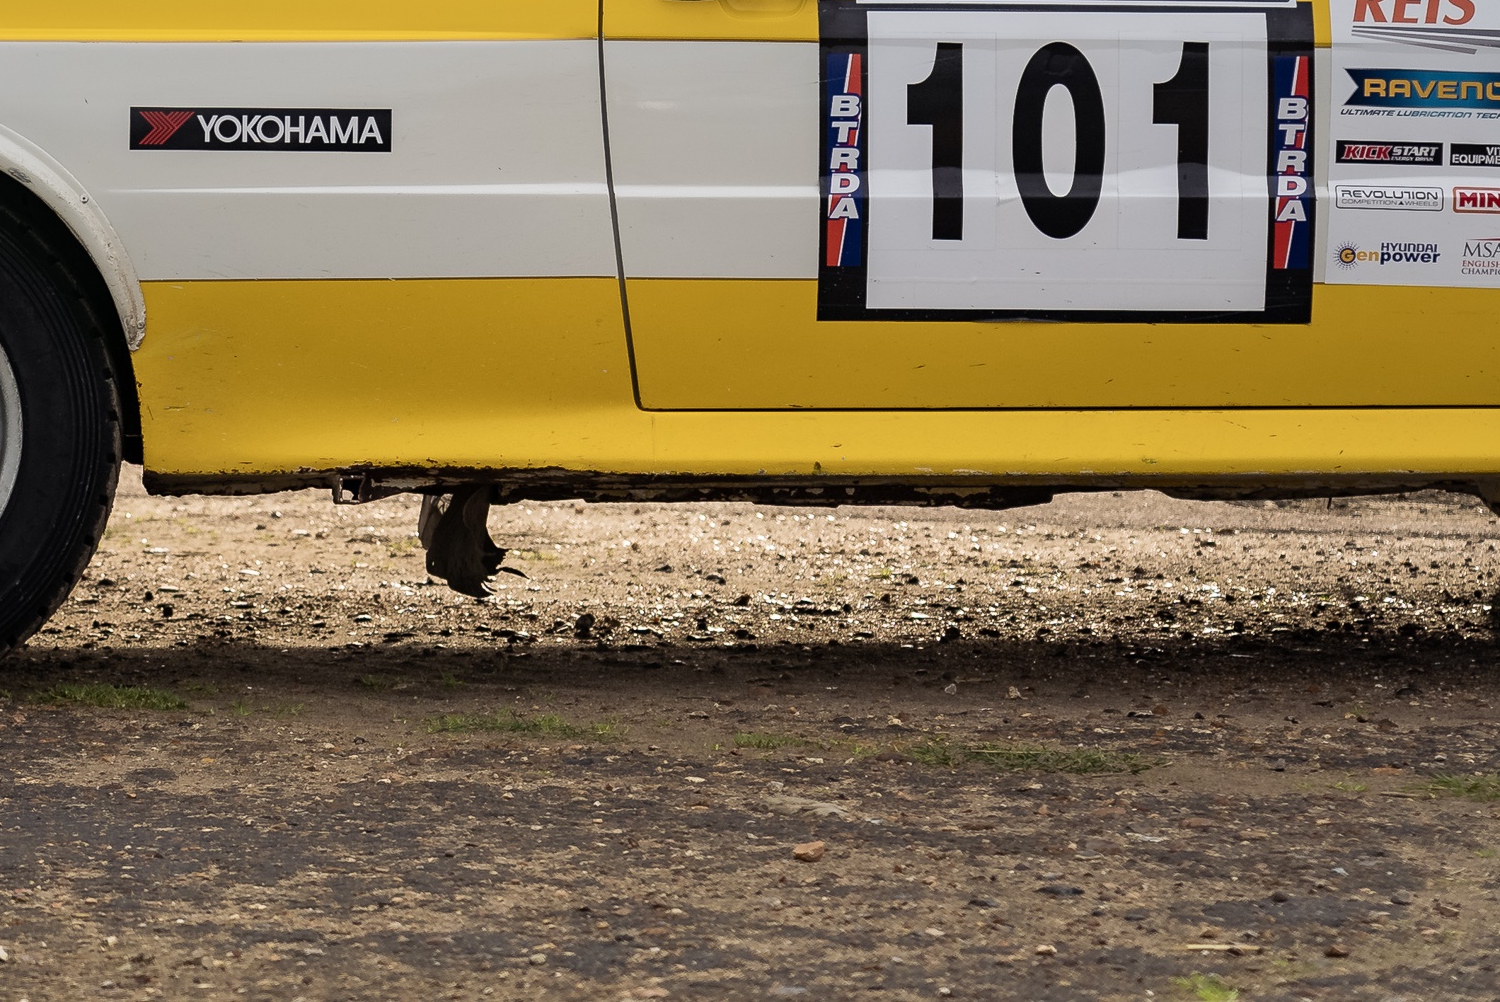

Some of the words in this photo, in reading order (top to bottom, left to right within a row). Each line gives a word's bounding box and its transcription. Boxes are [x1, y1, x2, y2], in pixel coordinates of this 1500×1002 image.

[1363, 78, 1500, 101] RAVENO
[1340, 108, 1395, 117] ULTIMATE
[1396, 109, 1473, 119] LUBRICATION
[196, 114, 384, 144] YOKOHAMA
[906, 40, 1210, 241] 101
[829, 94, 861, 220] BTRDA
[1276, 97, 1308, 223] BTRDA
[1341, 144, 1393, 161] KICK
[1392, 145, 1439, 157] START
[1452, 153, 1500, 165] EQUIPME
[1341, 189, 1438, 200] REVOLUTION
[1341, 198, 1398, 206] COMPETITION
[1380, 242, 1438, 253] HYUNDAI
